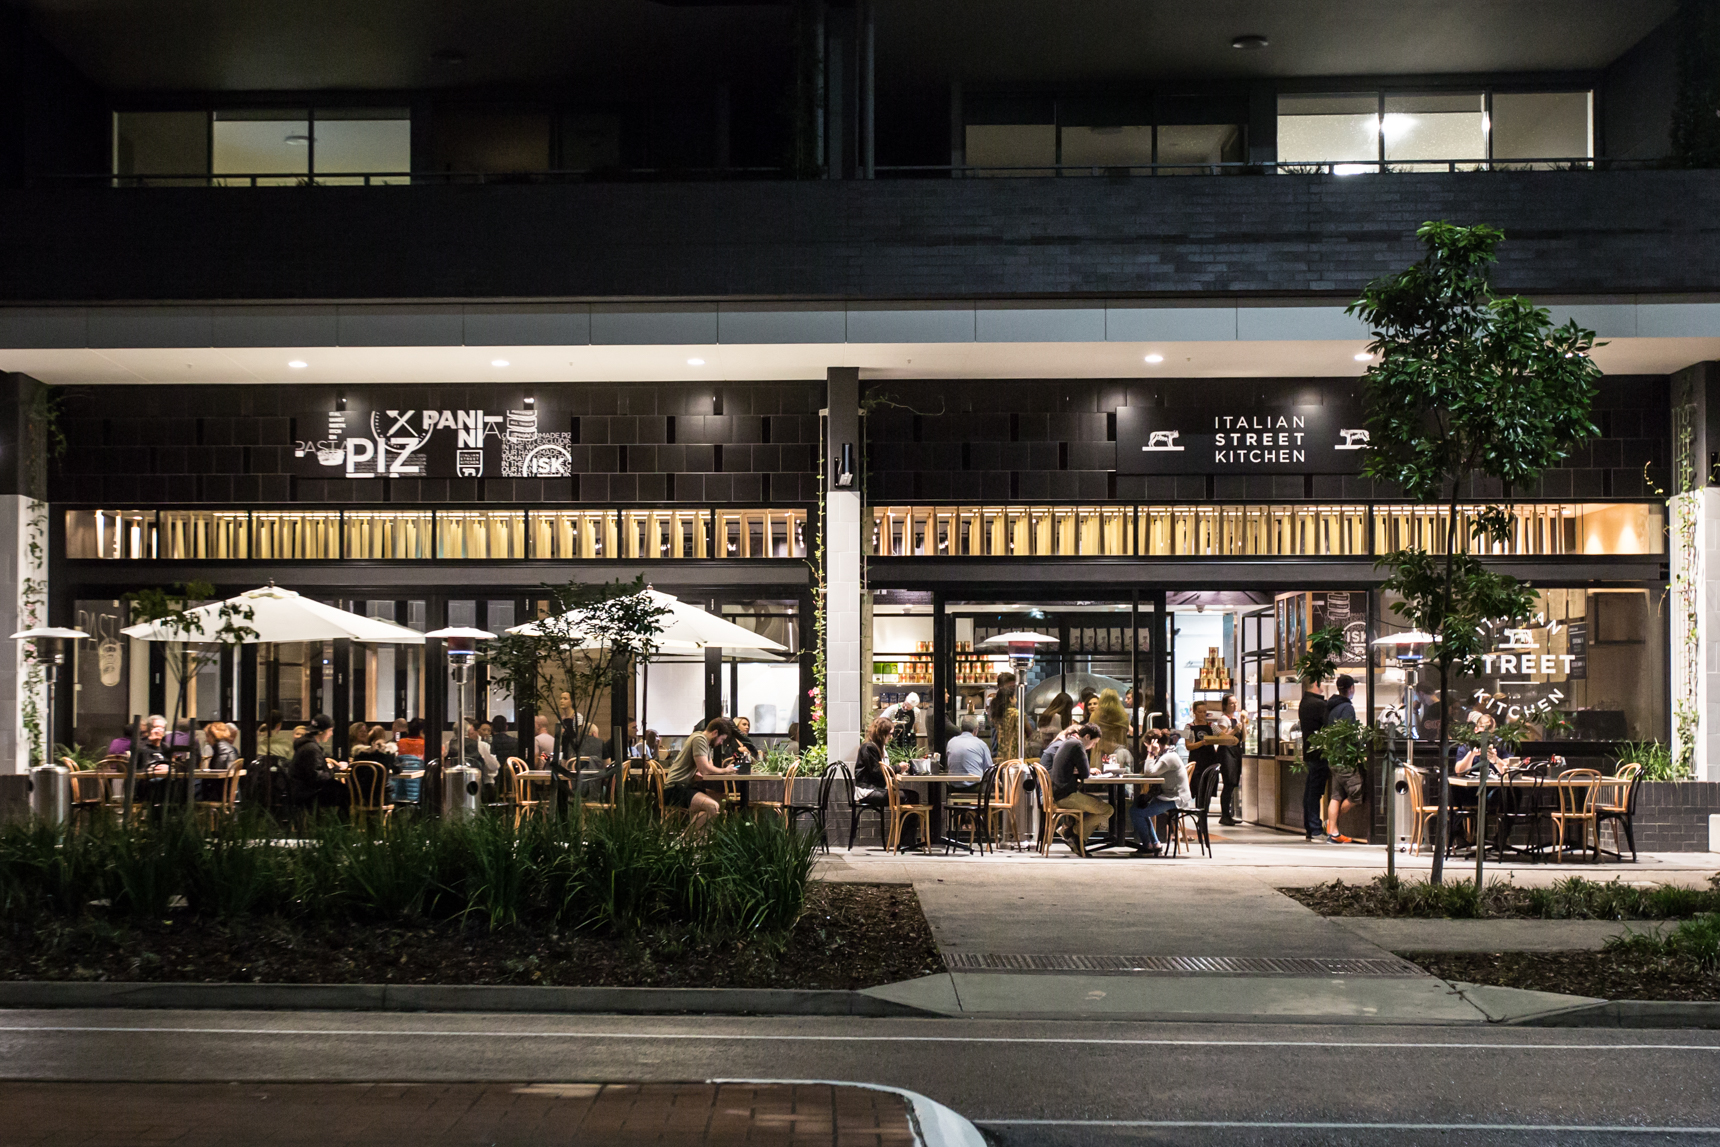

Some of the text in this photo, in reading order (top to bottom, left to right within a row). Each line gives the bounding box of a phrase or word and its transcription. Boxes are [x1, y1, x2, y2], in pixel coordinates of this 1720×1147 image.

[1215, 416, 1305, 429] ITALIAN
[1215, 433, 1305, 446] STREET
[346, 437, 420, 473] PIZ
[1215, 450, 1305, 463] KITCHEN
[532, 457, 565, 474] ISK
[1473, 688, 1565, 718] KITCHEN
